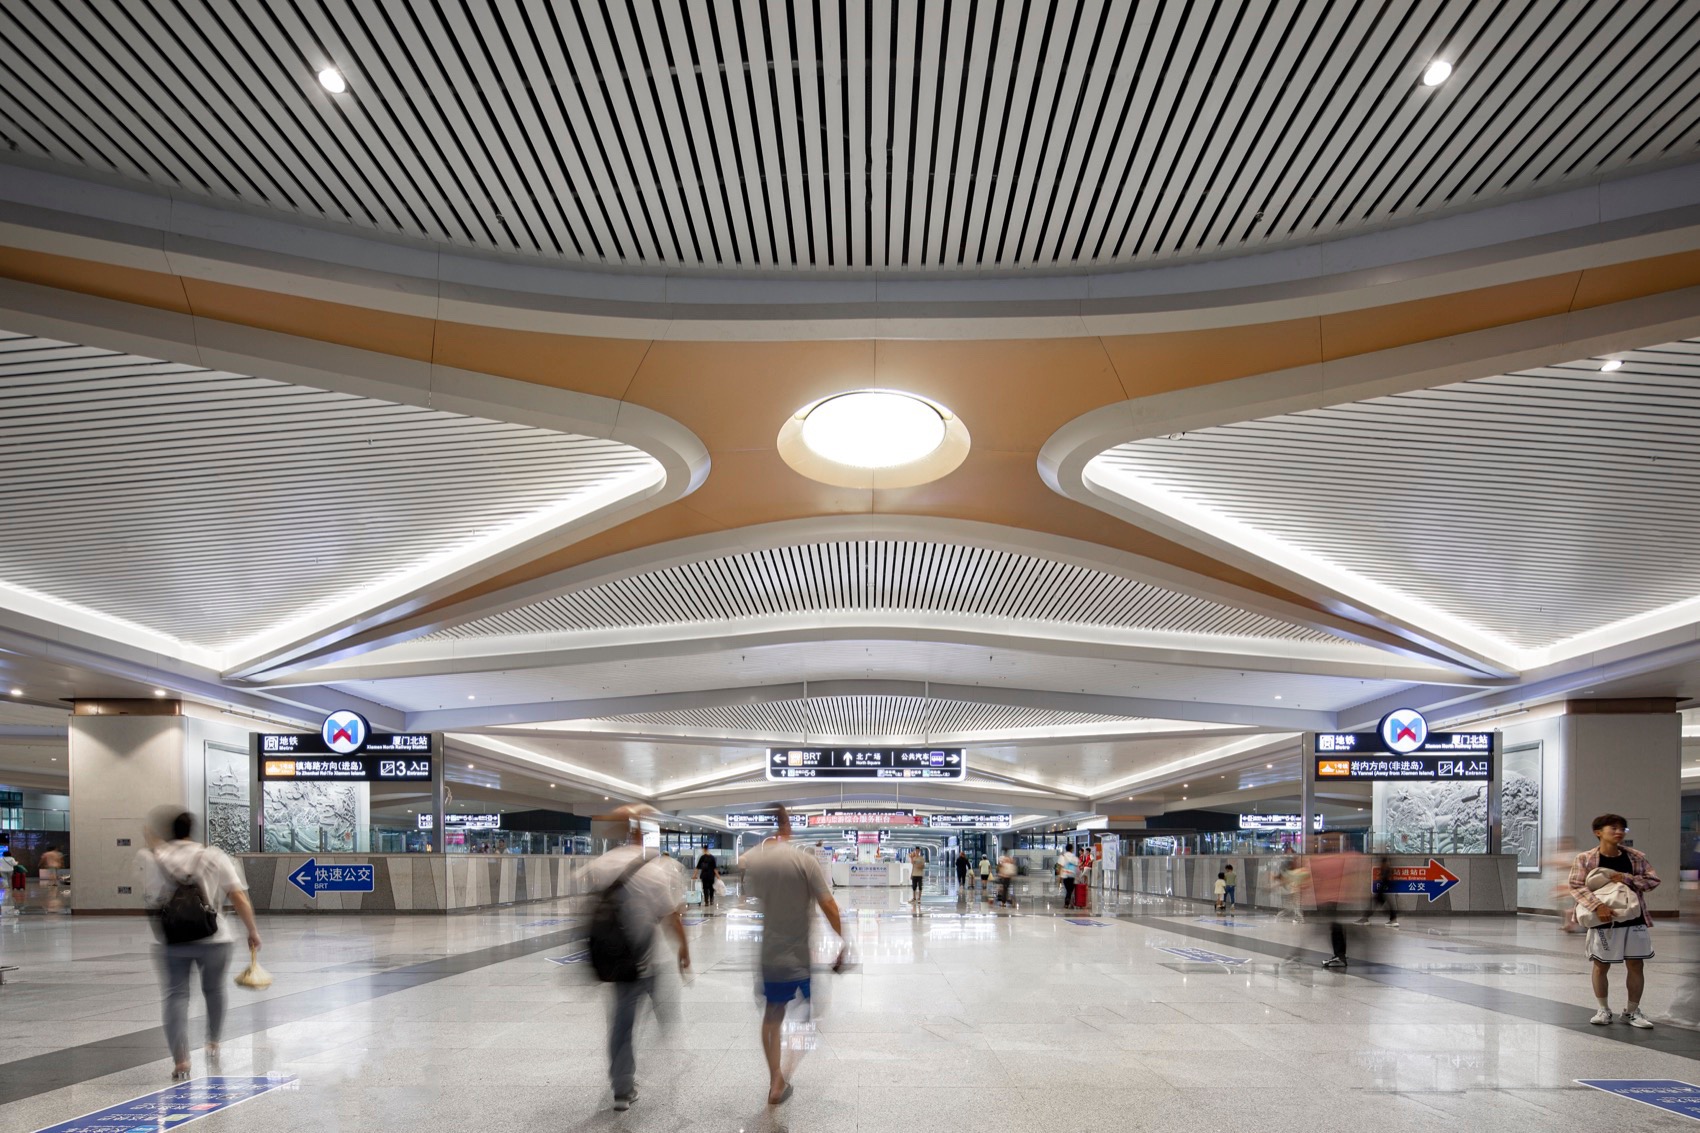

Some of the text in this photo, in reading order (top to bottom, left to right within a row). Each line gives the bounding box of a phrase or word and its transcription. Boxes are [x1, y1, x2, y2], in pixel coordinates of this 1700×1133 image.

[279, 736, 298, 746] 地铁
[392, 735, 428, 745] 厦门北站
[1335, 735, 1355, 745] 地铁
[1452, 734, 1488, 745] 厦门北站
[803, 752, 822, 760] BRT
[856, 752, 881, 761] 北广场
[901, 752, 930, 761] 公共汽车
[396, 760, 406, 776] 3
[410, 761, 429, 771] 入口
[1351, 761, 1424, 771] 岩内方向(非进岛)
[1453, 760, 1464, 776] 4
[1469, 761, 1488, 771] 入口
[314, 867, 371, 882] 快速公交
[1408, 882, 1426, 891] 公交
